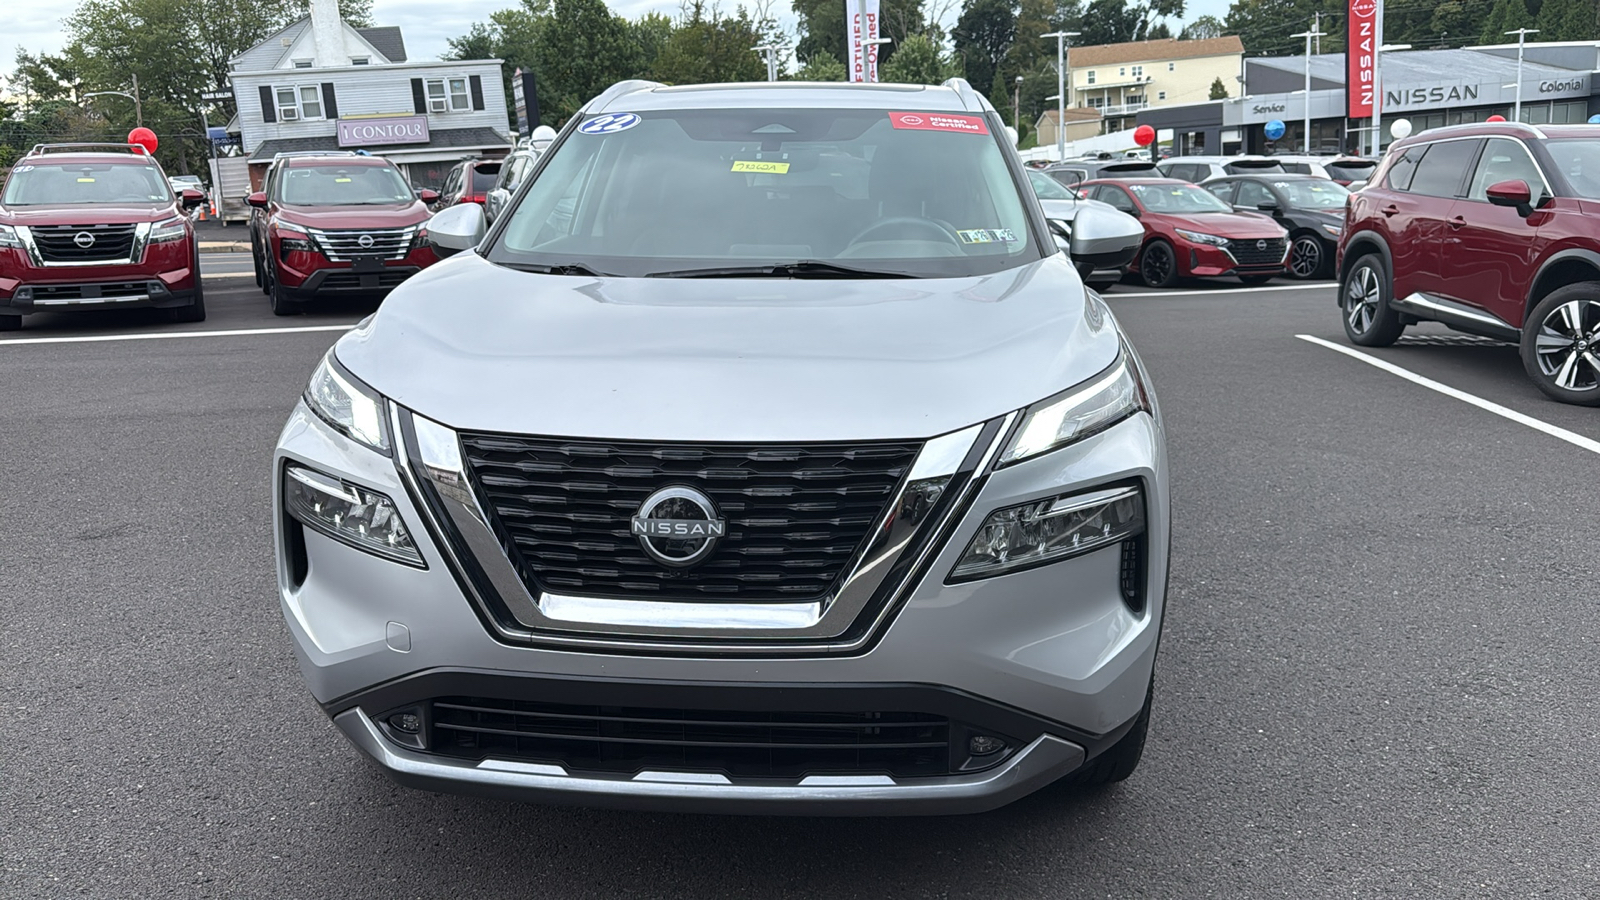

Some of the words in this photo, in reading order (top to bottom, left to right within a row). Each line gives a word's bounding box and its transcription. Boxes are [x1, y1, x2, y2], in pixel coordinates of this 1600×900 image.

[854, 13, 863, 82] ERTIFIED
[866, 13, 877, 82] re-Owned
[1360, 22, 1372, 105] NISSAN
[1539, 78, 1584, 93] Colonial
[215, 91, 232, 99] SALON
[1386, 84, 1478, 106] NISSAN
[1252, 103, 1285, 114] Service
[352, 123, 422, 139] CONTOUR
[584, 115, 634, 131] 22
[931, 121, 979, 130] Certified
[634, 521, 722, 535] NISSAN
